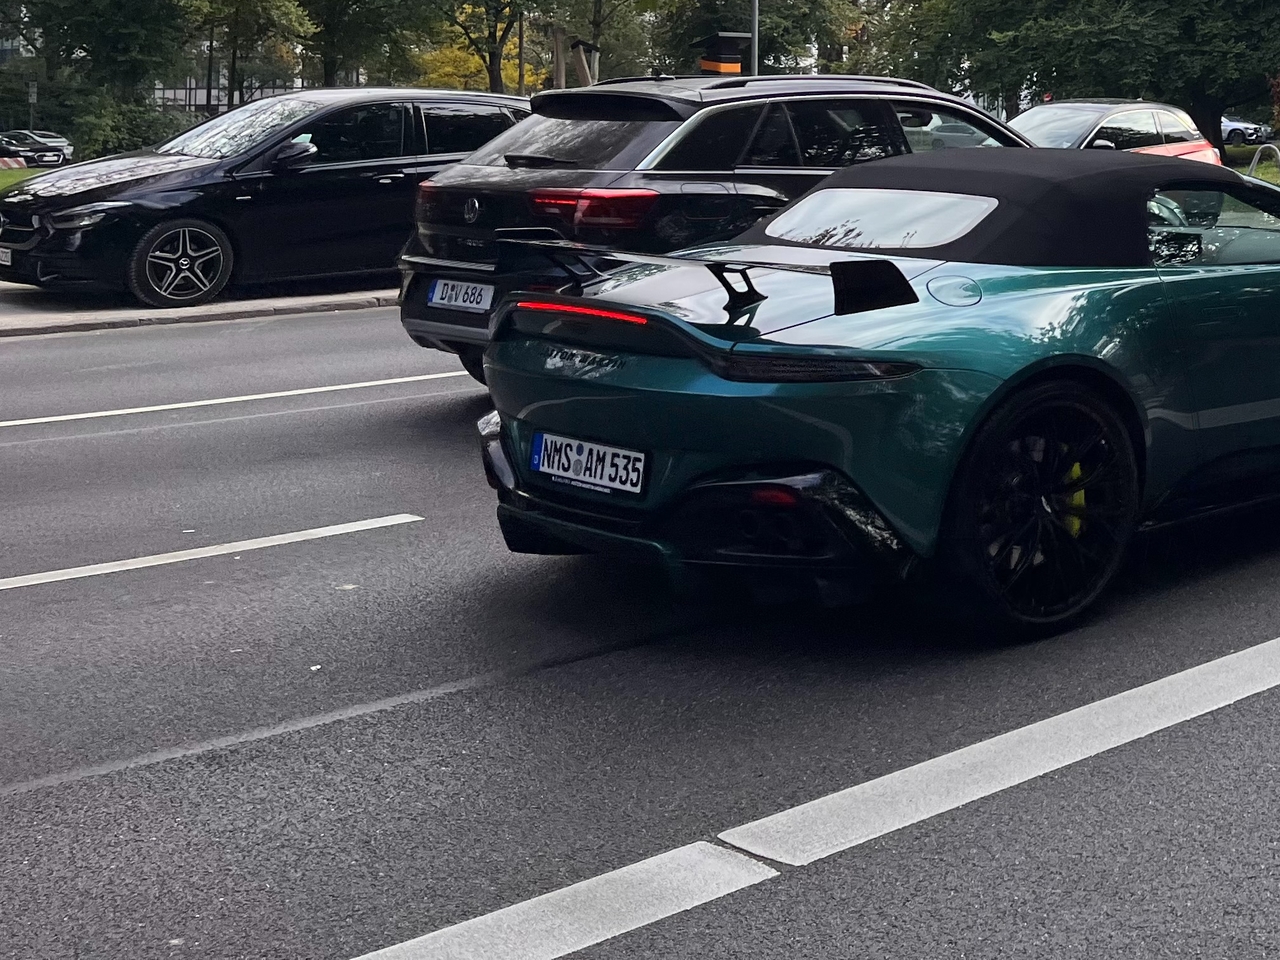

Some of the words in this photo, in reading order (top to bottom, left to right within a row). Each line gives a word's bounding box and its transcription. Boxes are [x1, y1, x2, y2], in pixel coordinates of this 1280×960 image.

[440, 283, 449, 301] D
[454, 284, 463, 302] V
[462, 285, 483, 305] 686
[541, 438, 573, 472] NMS
[583, 447, 606, 481] AM
[608, 452, 642, 487] 535
